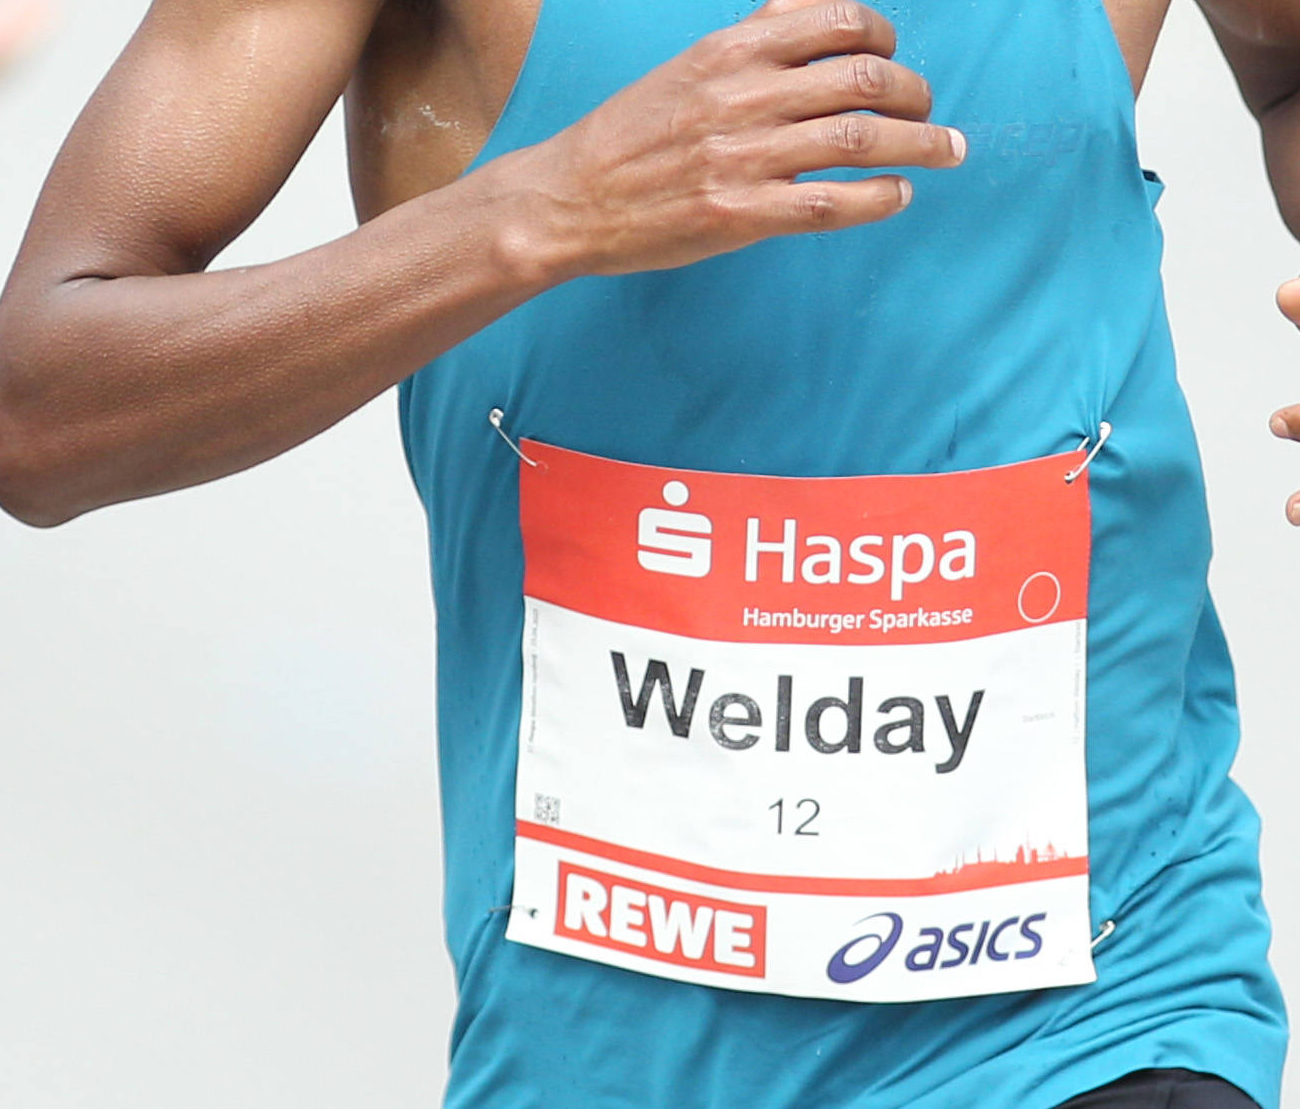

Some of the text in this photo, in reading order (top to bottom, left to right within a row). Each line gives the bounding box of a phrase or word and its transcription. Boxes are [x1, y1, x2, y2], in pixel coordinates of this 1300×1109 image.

[744, 516, 977, 601] Haspa
[742, 607, 974, 634] Hamburger Sparkasse
[610, 649, 985, 774] Welday
[767, 797, 821, 836] 12
[564, 871, 758, 969] REWE
[904, 912, 1048, 973] asics
